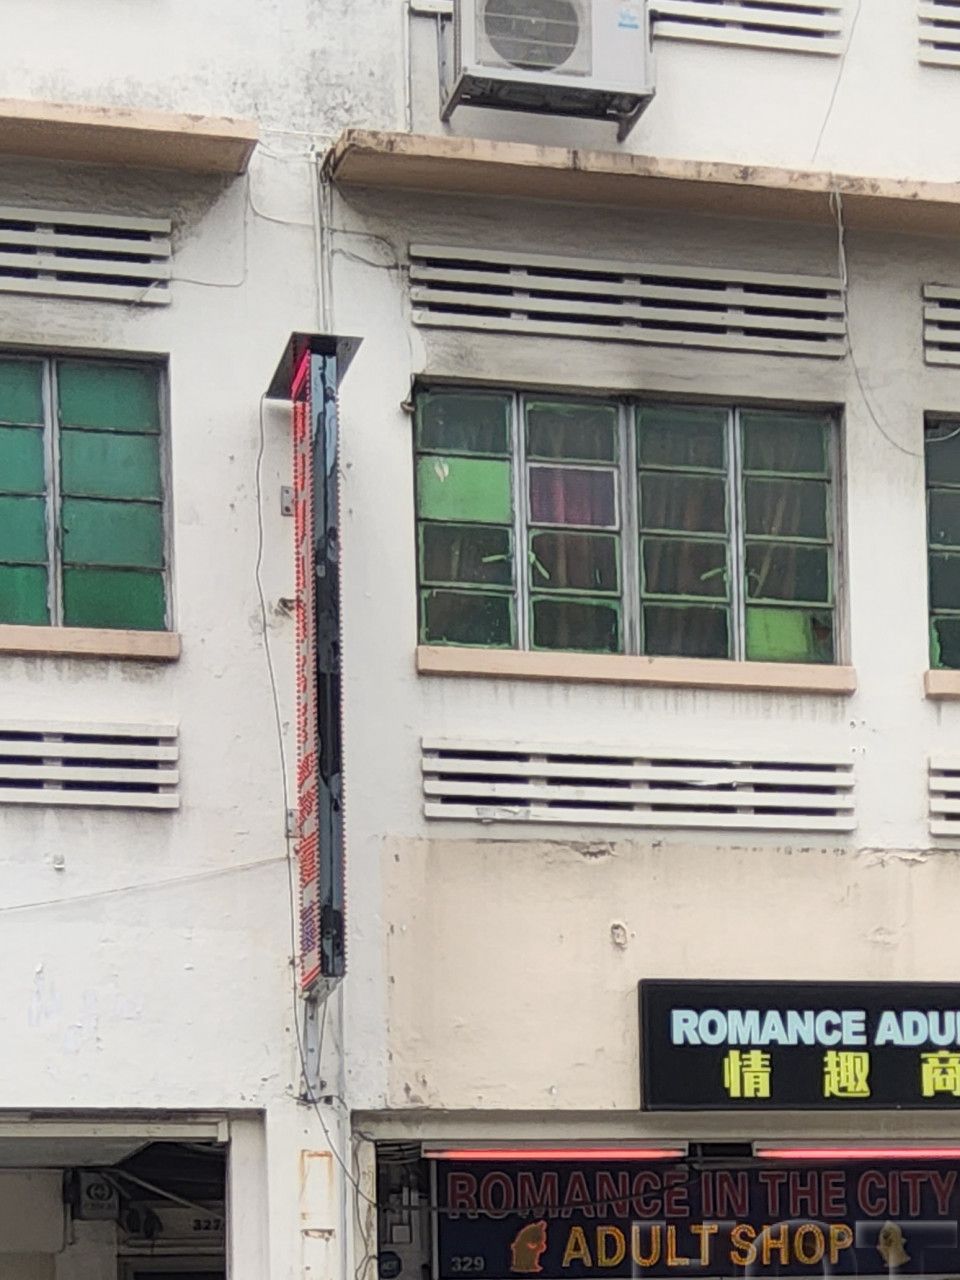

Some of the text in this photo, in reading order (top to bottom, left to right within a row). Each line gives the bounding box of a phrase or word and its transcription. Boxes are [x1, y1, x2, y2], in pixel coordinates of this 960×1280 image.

[671, 1009, 867, 1046] ROMANCE
[447, 1169, 958, 1219] ROMANCE IN THE CITY
[451, 1256, 485, 1272] 329
[561, 1222, 853, 1268] ADULT SHOP
